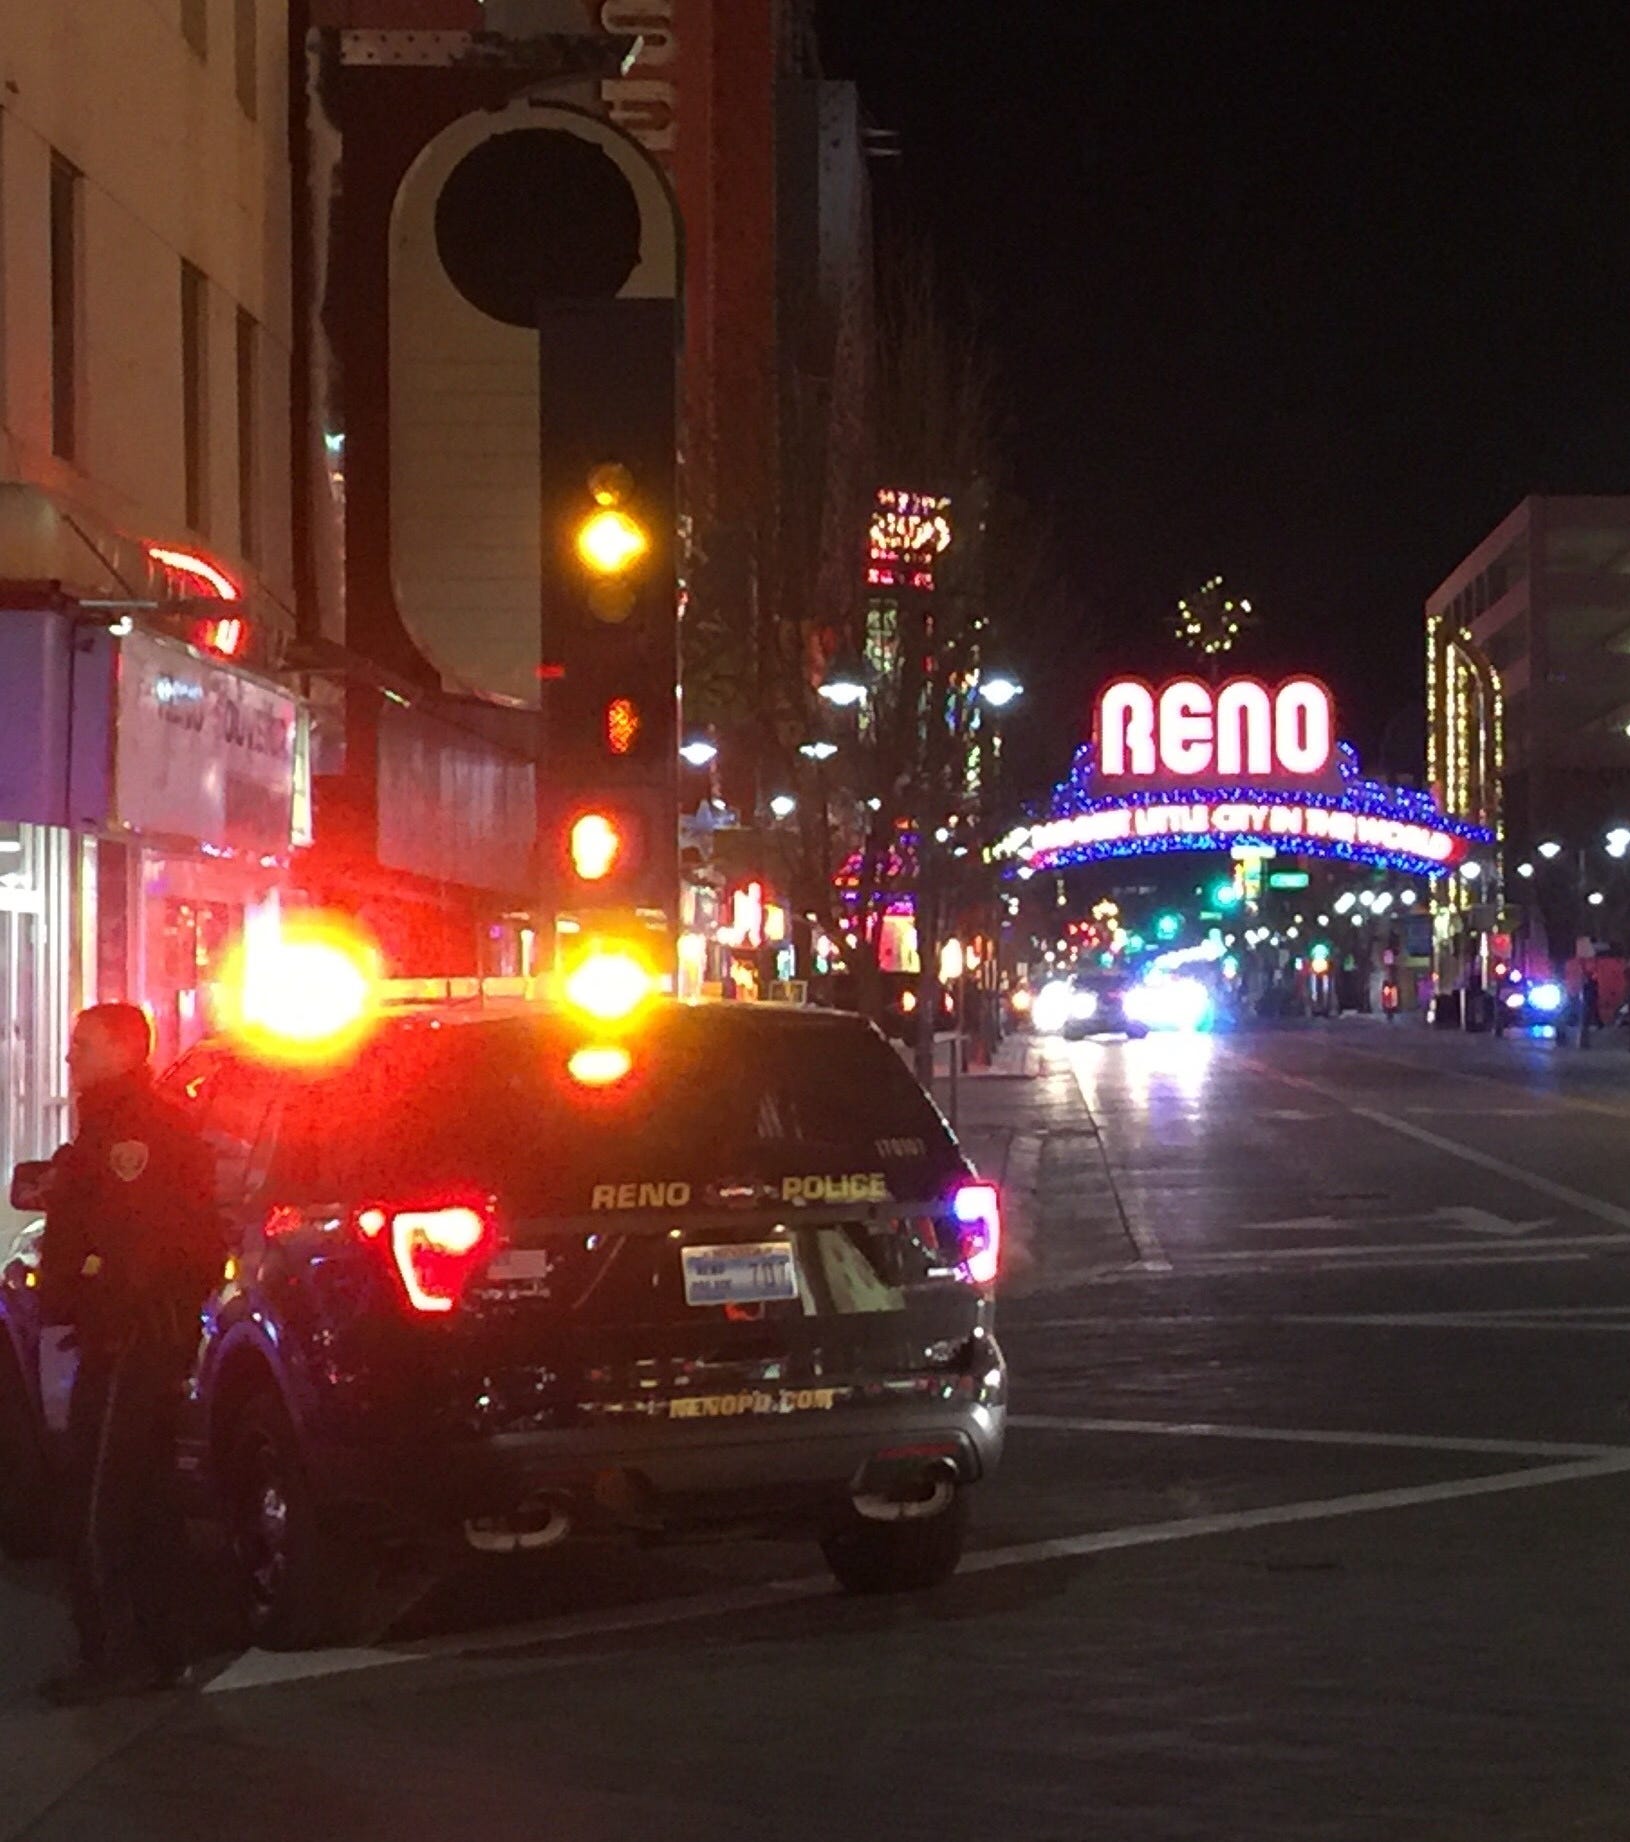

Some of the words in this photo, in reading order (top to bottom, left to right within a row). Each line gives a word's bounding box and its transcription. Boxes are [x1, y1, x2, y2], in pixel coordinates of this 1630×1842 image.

[1101, 681, 1330, 775] RENO
[590, 1181, 691, 1210] RENO
[781, 1172, 887, 1201] POLICE
